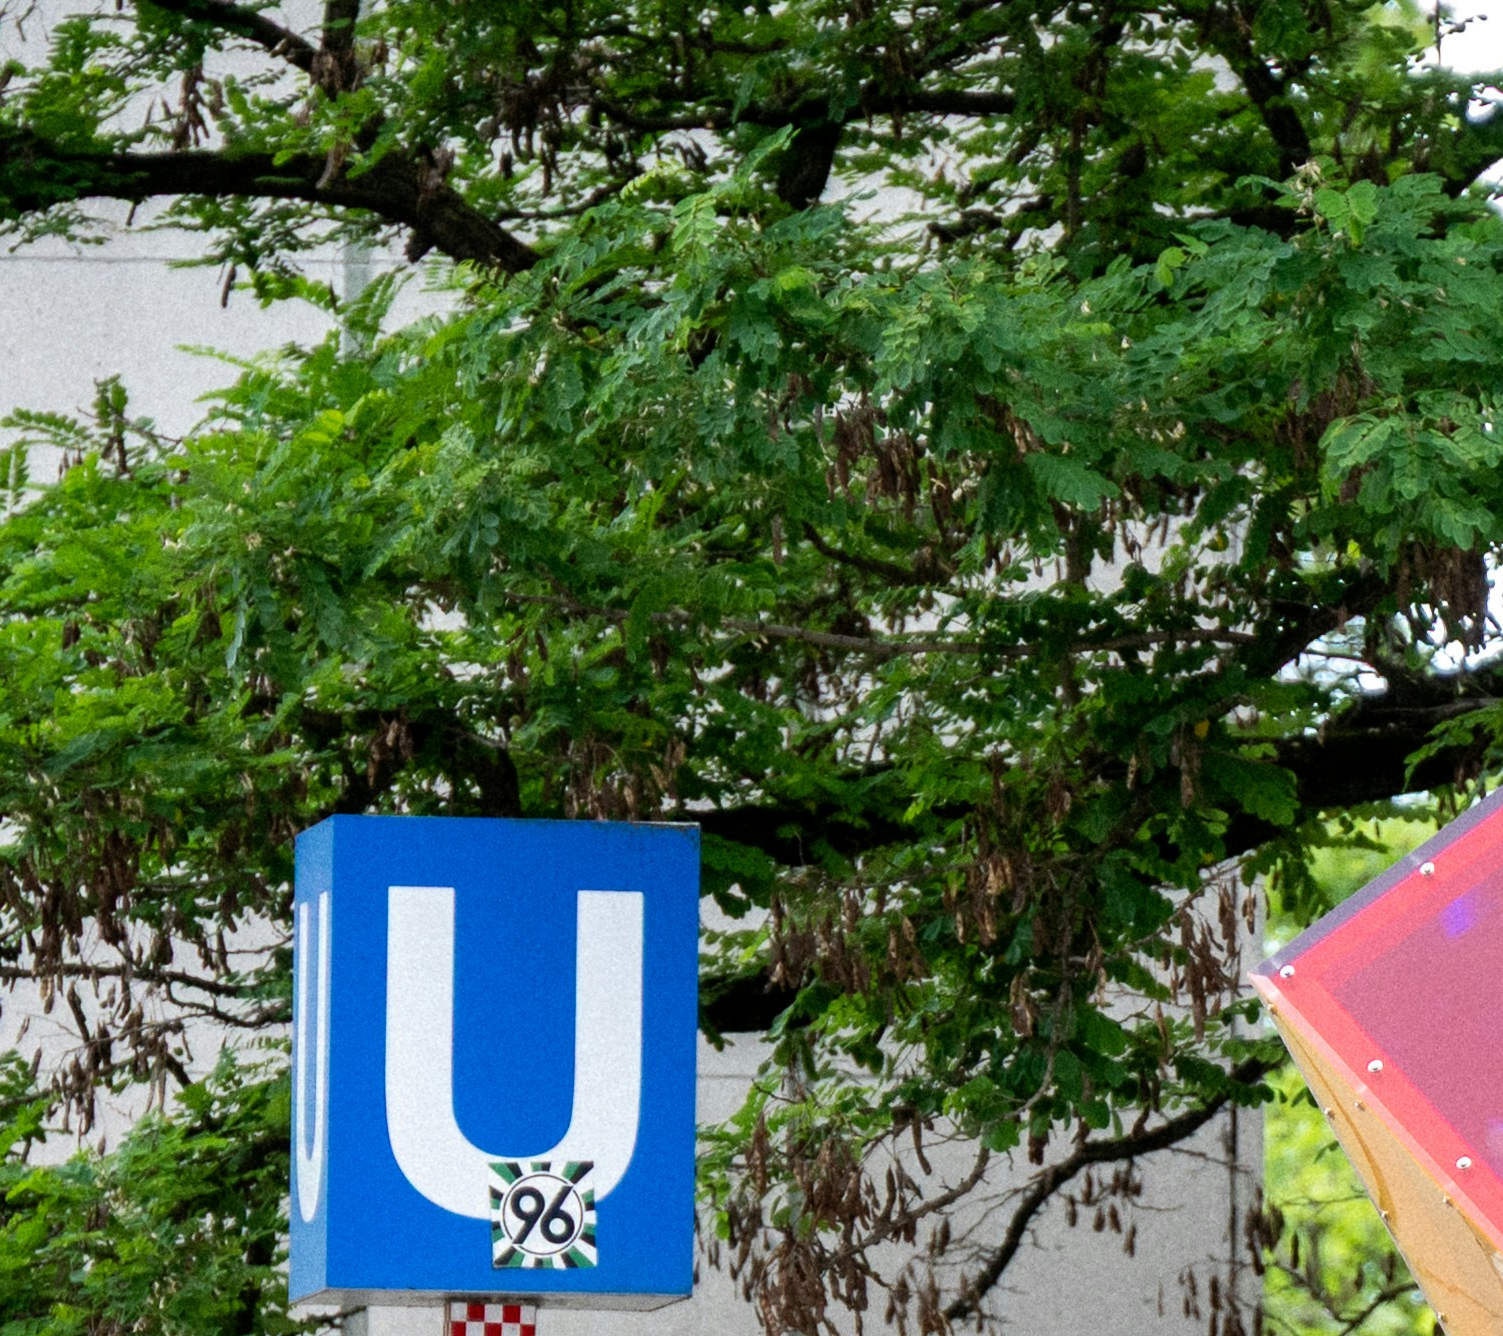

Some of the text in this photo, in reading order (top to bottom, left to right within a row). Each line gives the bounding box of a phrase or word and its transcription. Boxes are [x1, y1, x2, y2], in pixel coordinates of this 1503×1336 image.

[297, 891, 328, 1223] U
[385, 886, 644, 1220] U
[510, 1185, 575, 1245] 96
